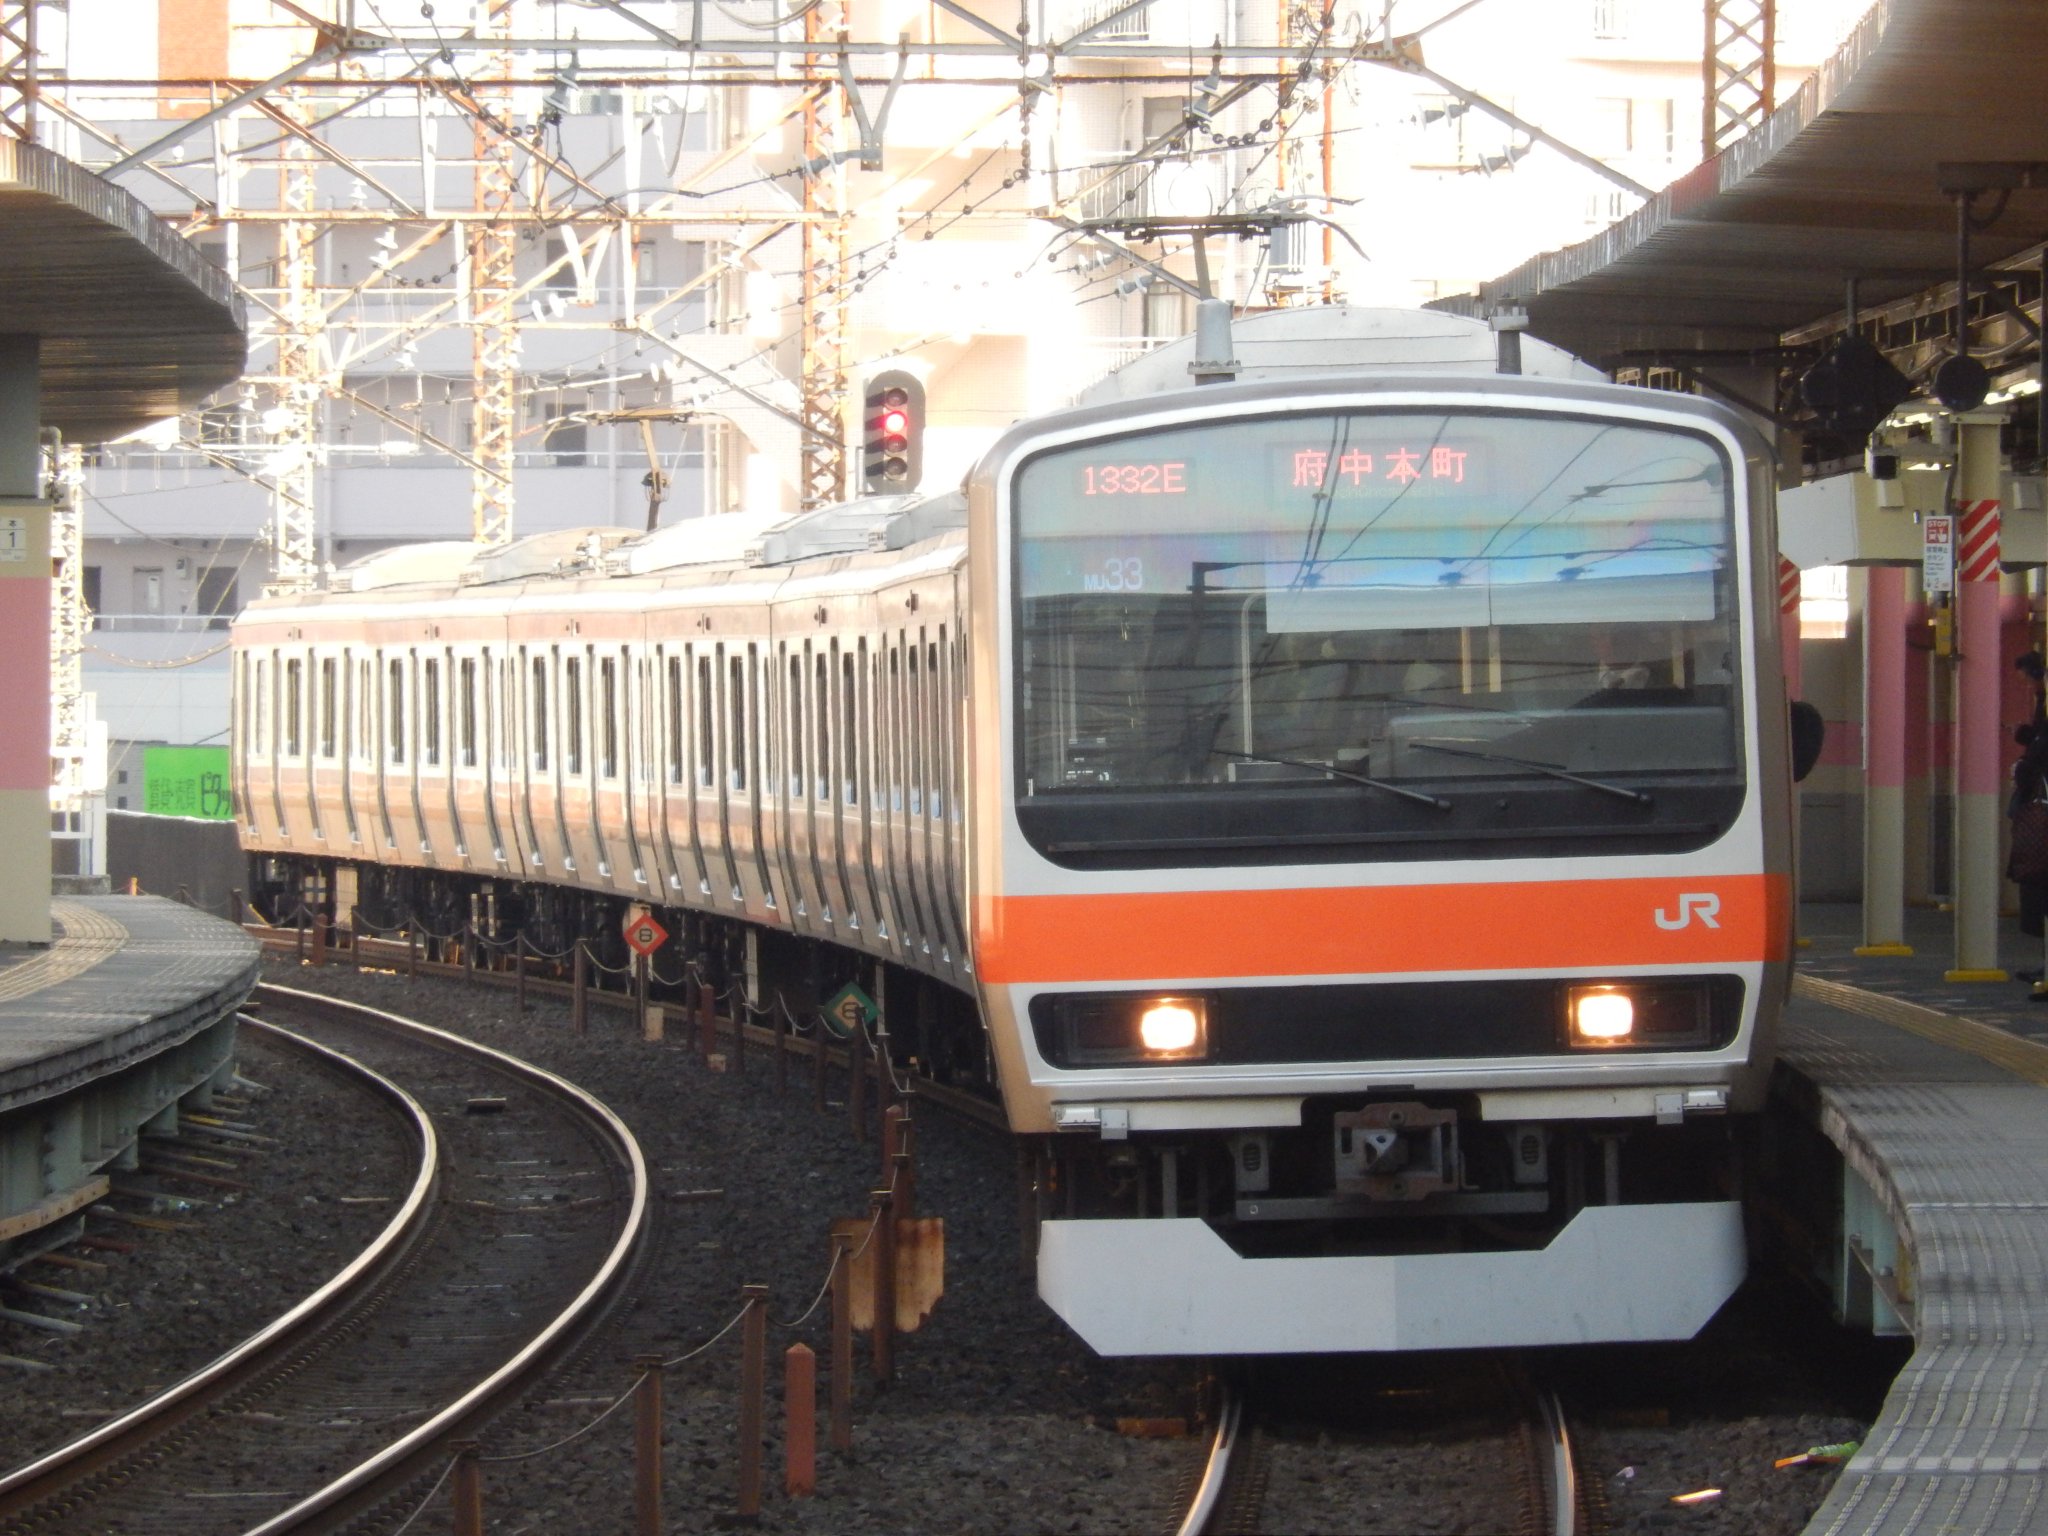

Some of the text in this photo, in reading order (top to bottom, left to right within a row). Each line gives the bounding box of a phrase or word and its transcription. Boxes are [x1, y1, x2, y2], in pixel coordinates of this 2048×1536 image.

[1085, 463, 1187, 496] 1332E
[1292, 447, 1467, 487] 府中本町
[1928, 520, 1948, 528] STOP
[1655, 893, 1720, 930] JR
